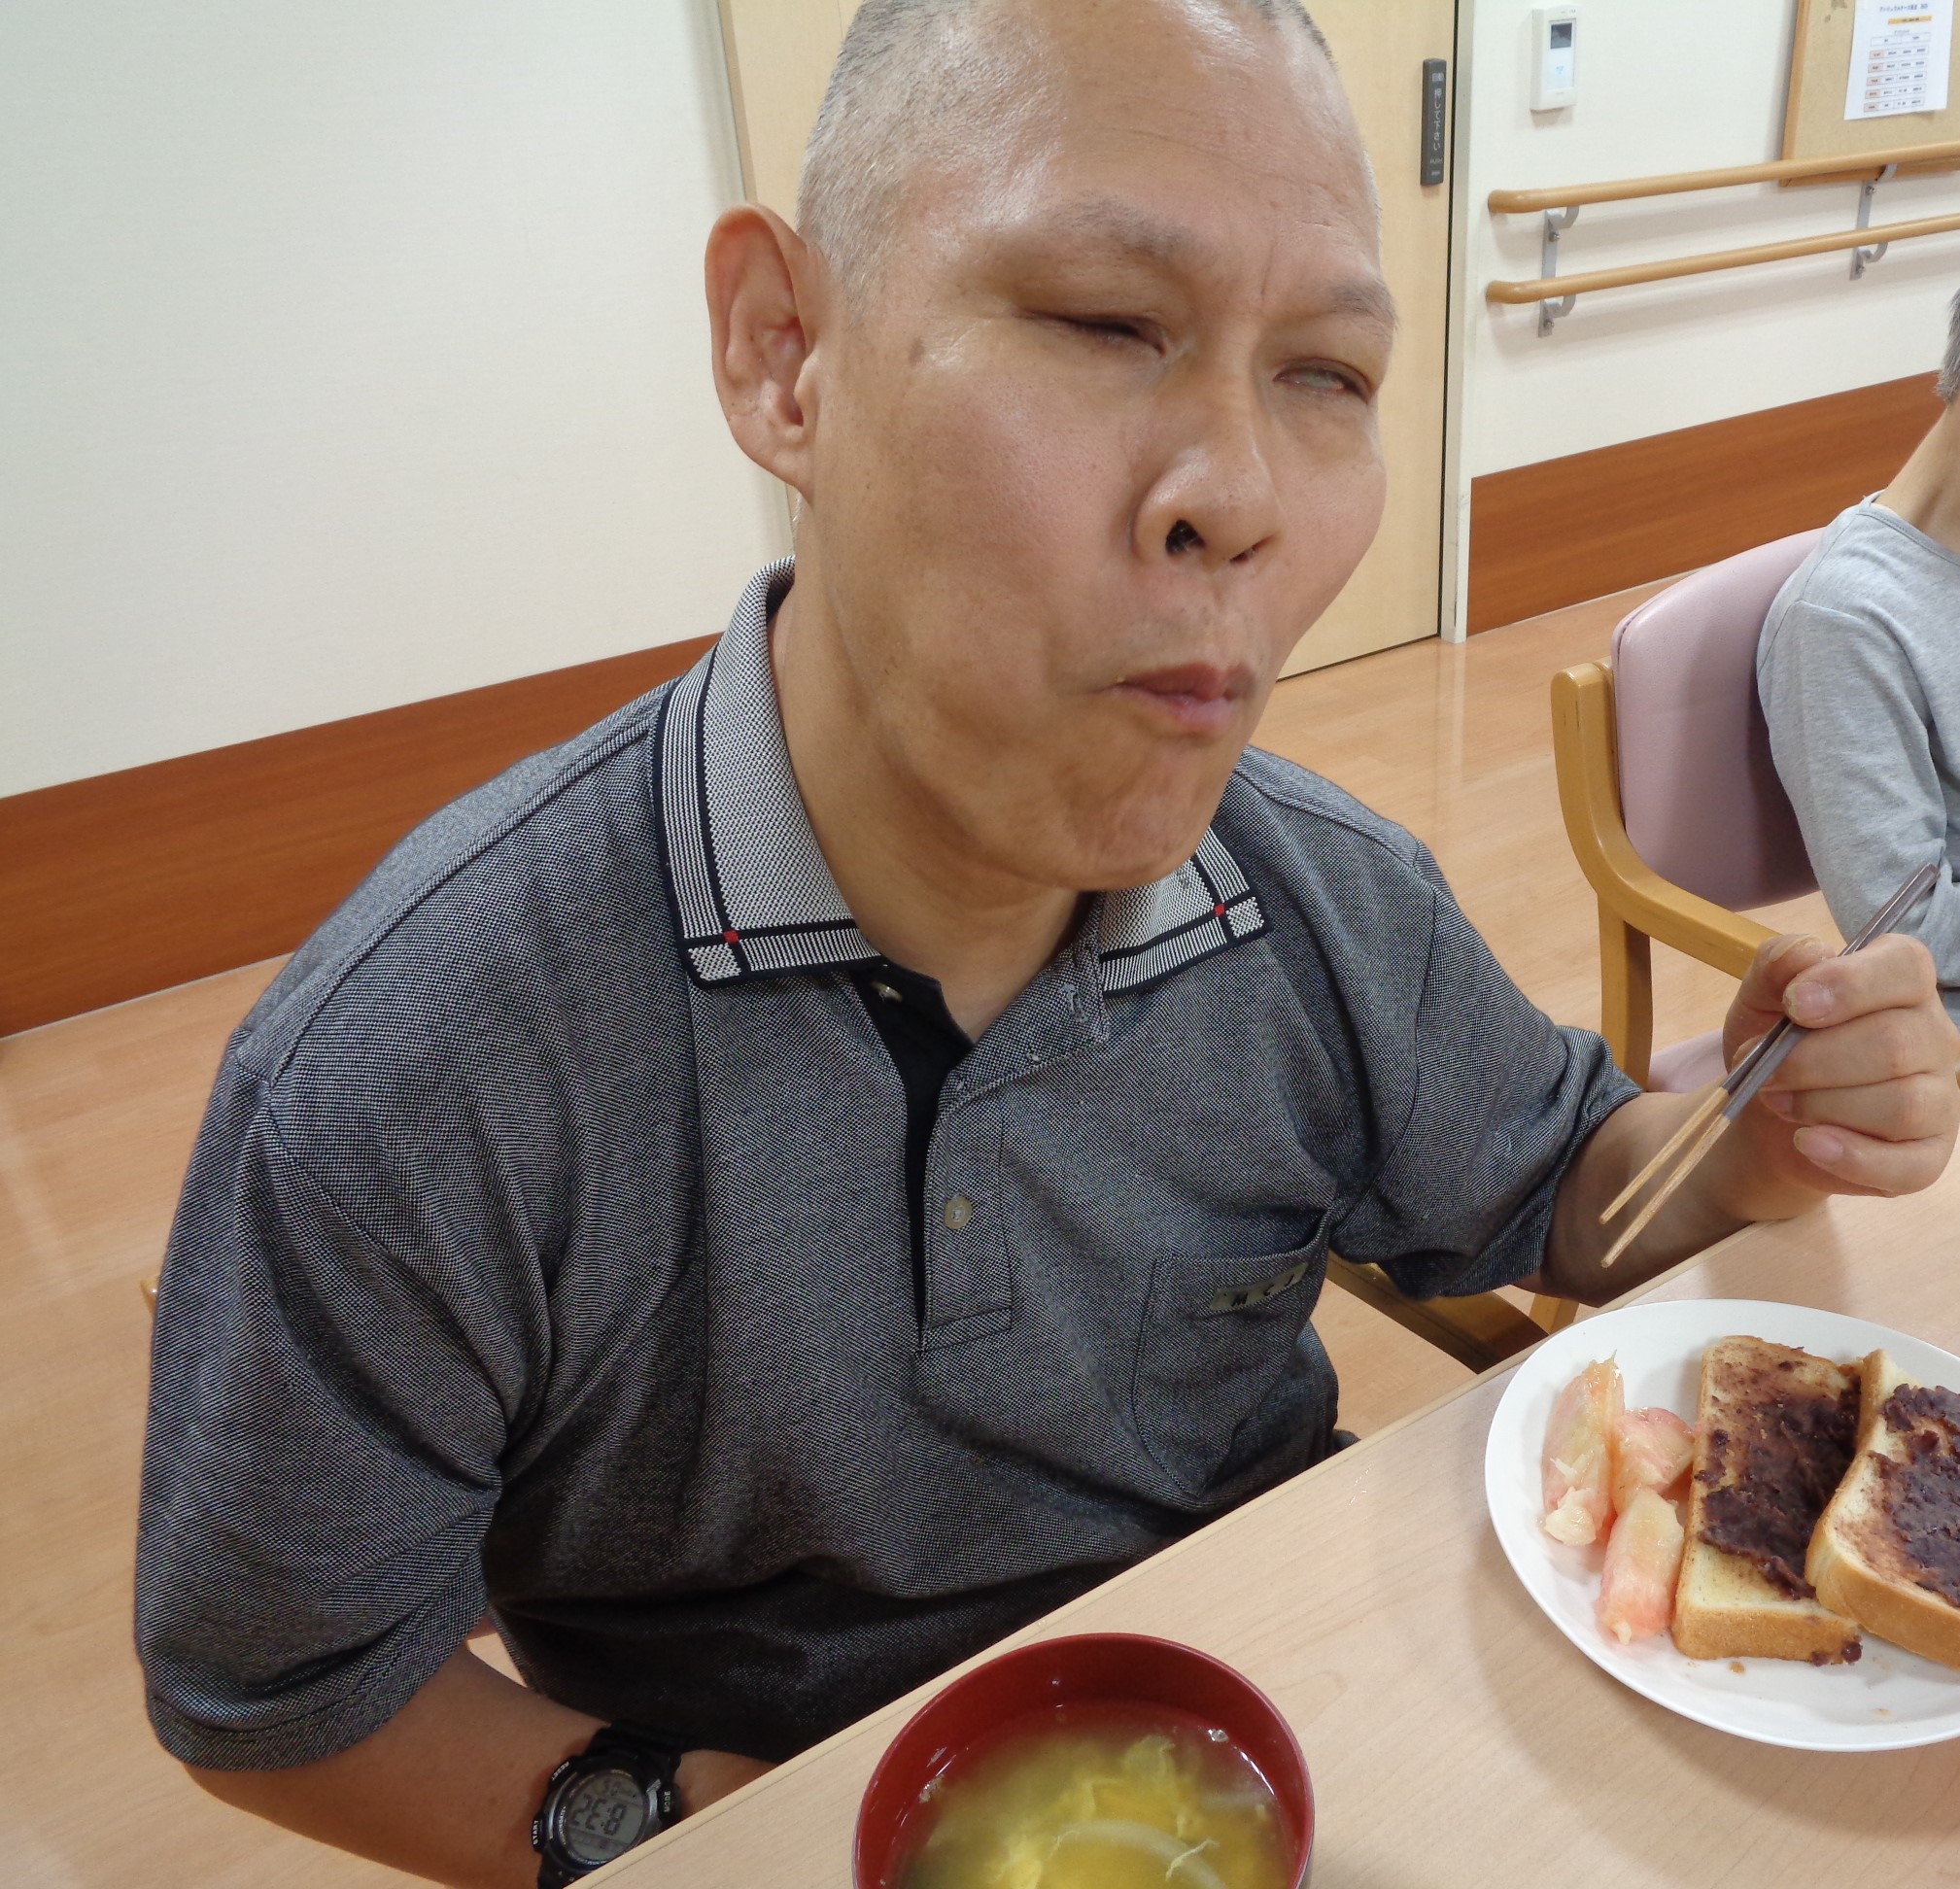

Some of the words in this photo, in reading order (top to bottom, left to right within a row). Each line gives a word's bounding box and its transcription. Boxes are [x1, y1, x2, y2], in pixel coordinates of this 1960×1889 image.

[1433, 88, 1442, 151] 押して下さい
